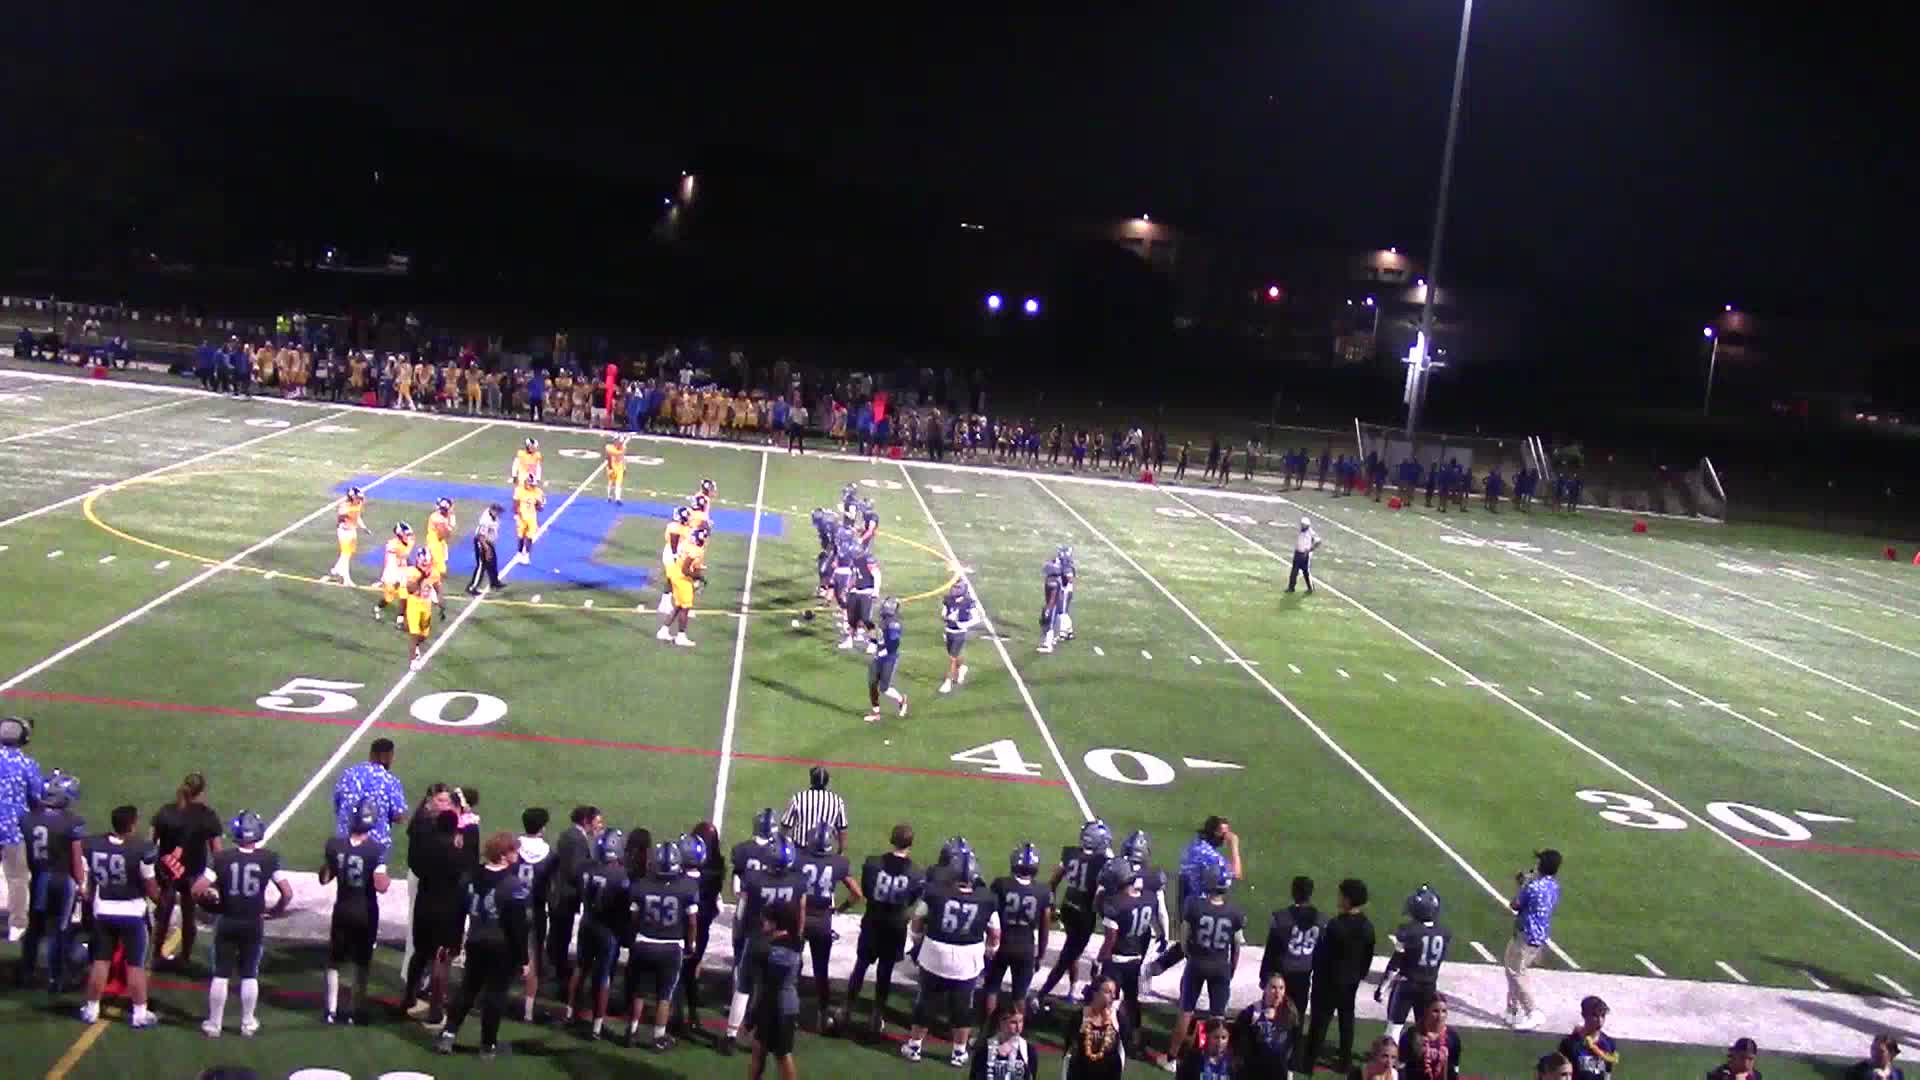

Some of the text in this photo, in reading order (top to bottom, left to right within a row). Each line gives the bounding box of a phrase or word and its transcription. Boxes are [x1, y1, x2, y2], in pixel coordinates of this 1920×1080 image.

[92, 851, 126, 886] 59
[229, 862, 261, 897] 16
[802, 863, 833, 897] 24
[1066, 859, 1087, 892] 21
[645, 894, 679, 926] 53
[942, 899, 979, 934] 67
[1130, 906, 1153, 938] 18
[1199, 917, 1232, 950] 26
[1418, 935, 1444, 967] 19
